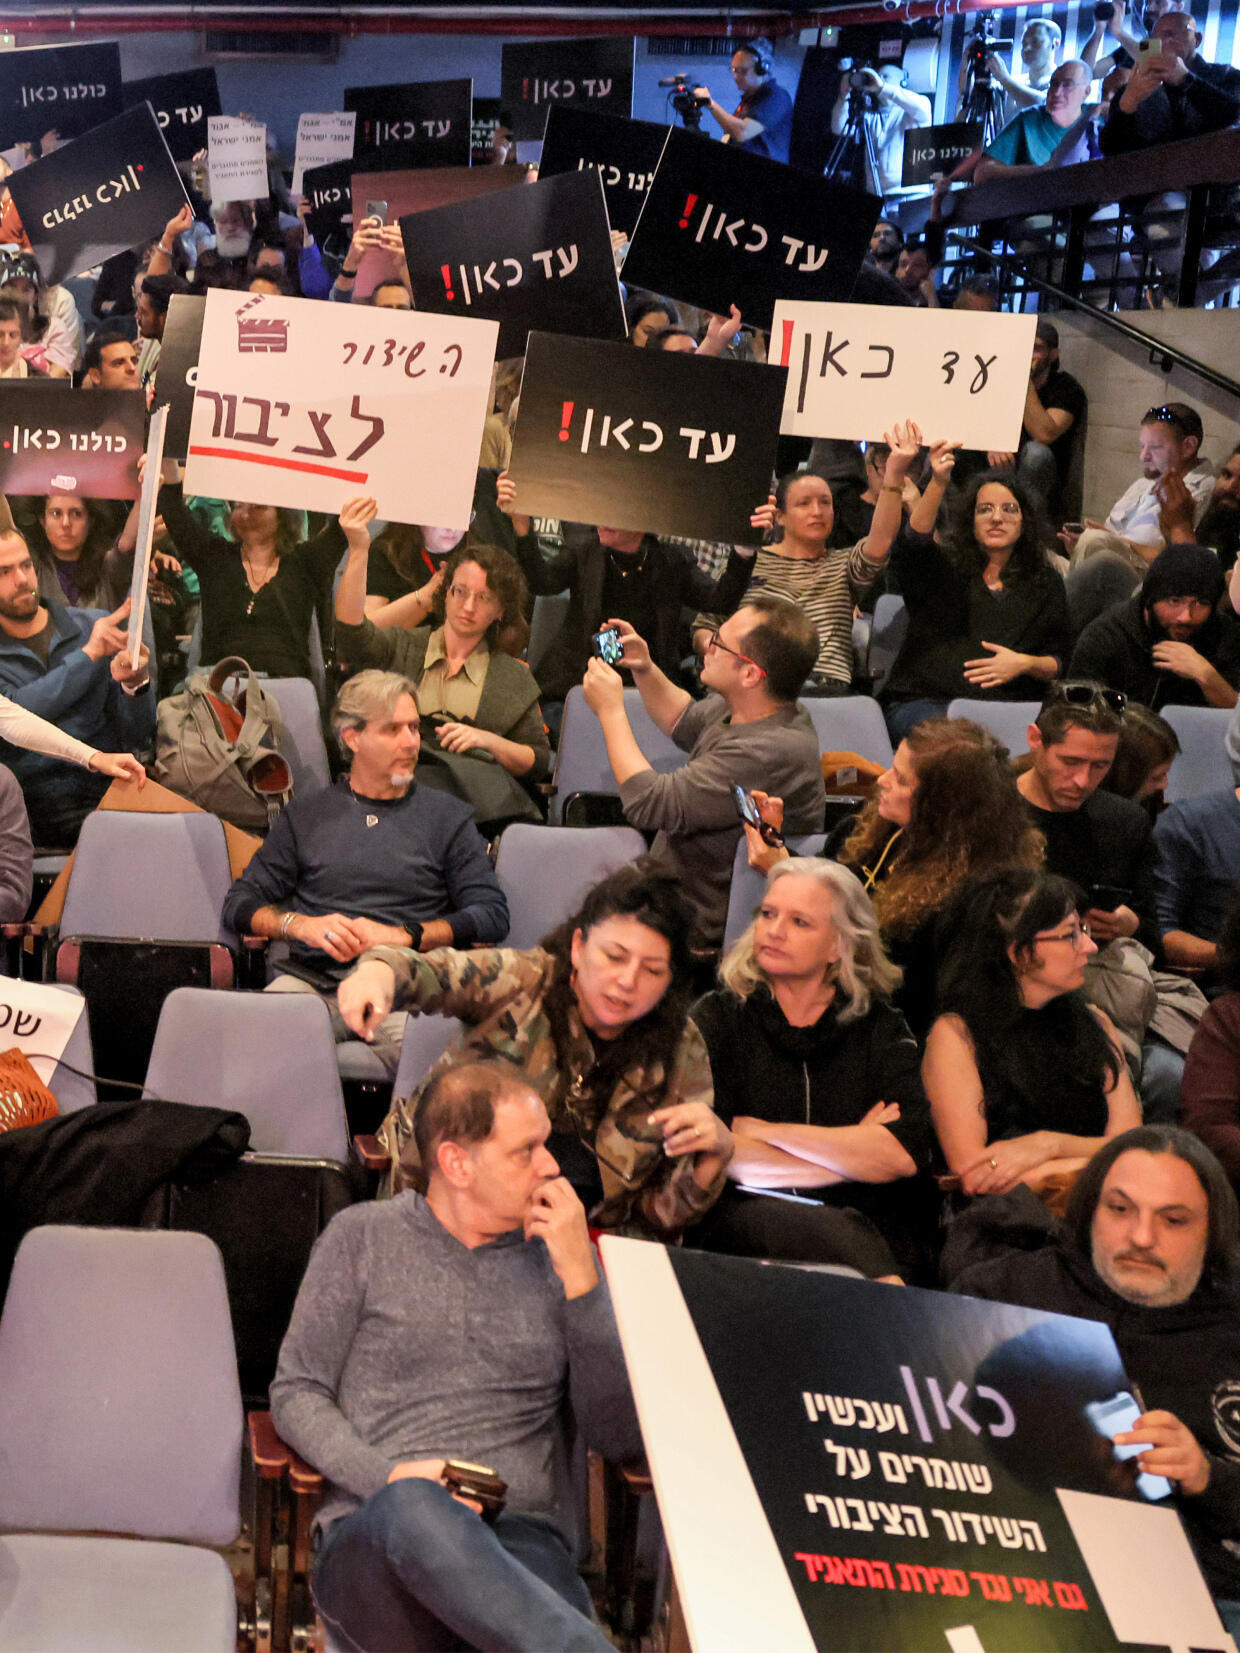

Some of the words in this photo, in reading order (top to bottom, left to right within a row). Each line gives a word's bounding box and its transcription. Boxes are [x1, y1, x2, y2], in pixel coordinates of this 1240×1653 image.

[63, 83, 106, 101] כולנו
[522, 77, 576, 105] כאן!
[582, 78, 612, 98] עד
[176, 104, 203, 124] עד
[422, 119, 451, 138] עד
[363, 119, 416, 147] כאן!
[940, 147, 973, 159] כולנו
[42, 194, 93, 229] כולנו
[96, 164, 144, 204] כאן.
[678, 193, 769, 253] כאן!
[531, 244, 579, 279] עד
[781, 235, 829, 273] עד
[440, 257, 524, 306] כאן!
[343, 338, 463, 378] השידור
[941, 350, 998, 395] עד
[2, 425, 61, 455] כאן.
[69, 431, 127, 453] כולנו
[196, 389, 385, 462] לציבור
[557, 401, 665, 455] כאן!
[679, 427, 736, 464] עד
[802, 1391, 909, 1435] ועכשיו
[900, 1365, 1017, 1443] כאן
[824, 1438, 872, 1480] על
[878, 1450, 993, 1495] שומרים
[805, 1493, 930, 1539] הציבורי
[931, 1508, 1047, 1553] השידור
[794, 1552, 897, 1590] התאגיד
[895, 1562, 971, 1598] סגירת
[969, 1570, 1013, 1602] נגד
[1012, 1575, 1054, 1607] אני
[1053, 1581, 1088, 1611] גם
